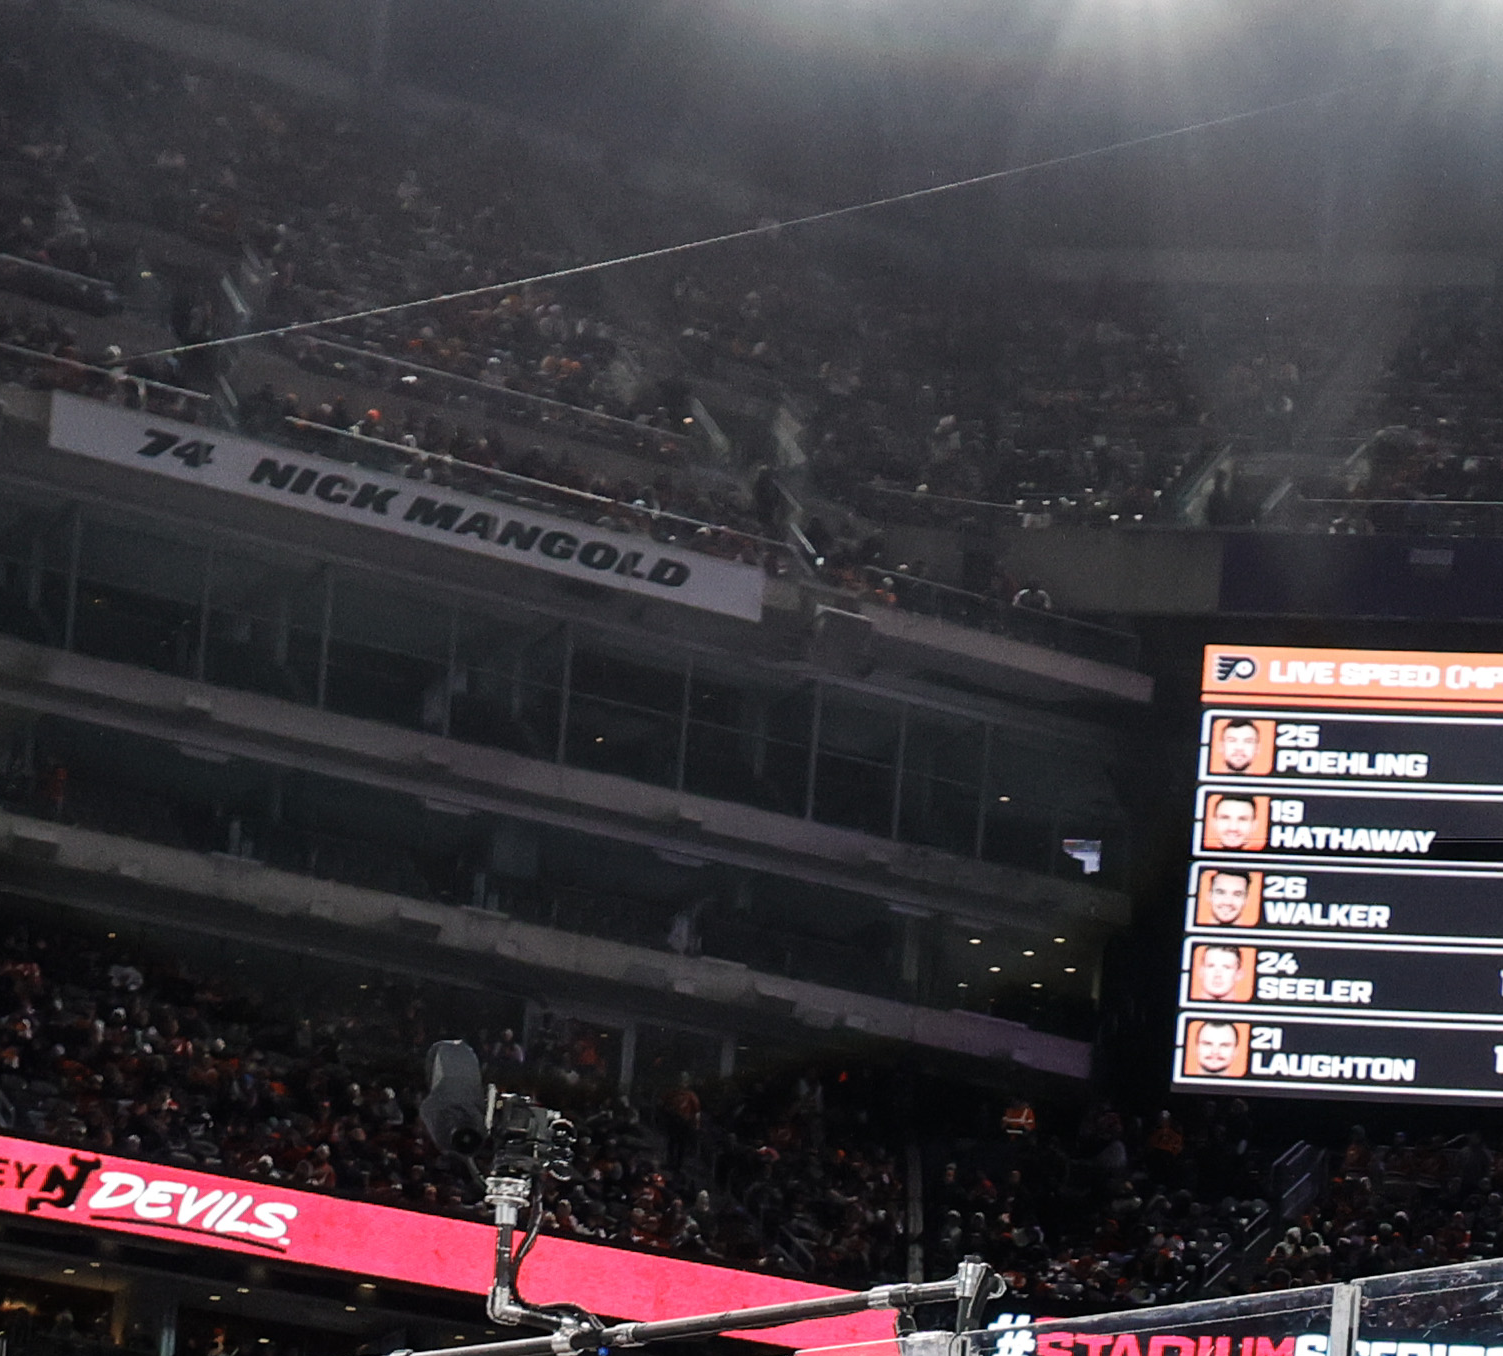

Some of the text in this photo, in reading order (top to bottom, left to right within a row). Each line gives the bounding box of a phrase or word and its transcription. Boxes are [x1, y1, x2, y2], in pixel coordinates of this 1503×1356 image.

[135, 428, 692, 589] 74 NICK MANGOLD
[1269, 660, 1334, 685] LIVE
[1340, 662, 1439, 690] SPEED
[1276, 724, 1321, 748] 25
[1276, 750, 1429, 777] POEHLING
[1269, 799, 1305, 823] 19
[1269, 826, 1436, 853] HATHAWAY
[1263, 876, 1308, 899] 26
[1263, 901, 1391, 928] WALKER
[1256, 951, 1298, 975] 24
[1256, 977, 1374, 1004] SEELER
[1251, 1027, 1283, 1050] 21
[1251, 1052, 1416, 1082] LAUGHTON
[88, 1171, 298, 1240] DEVILS
